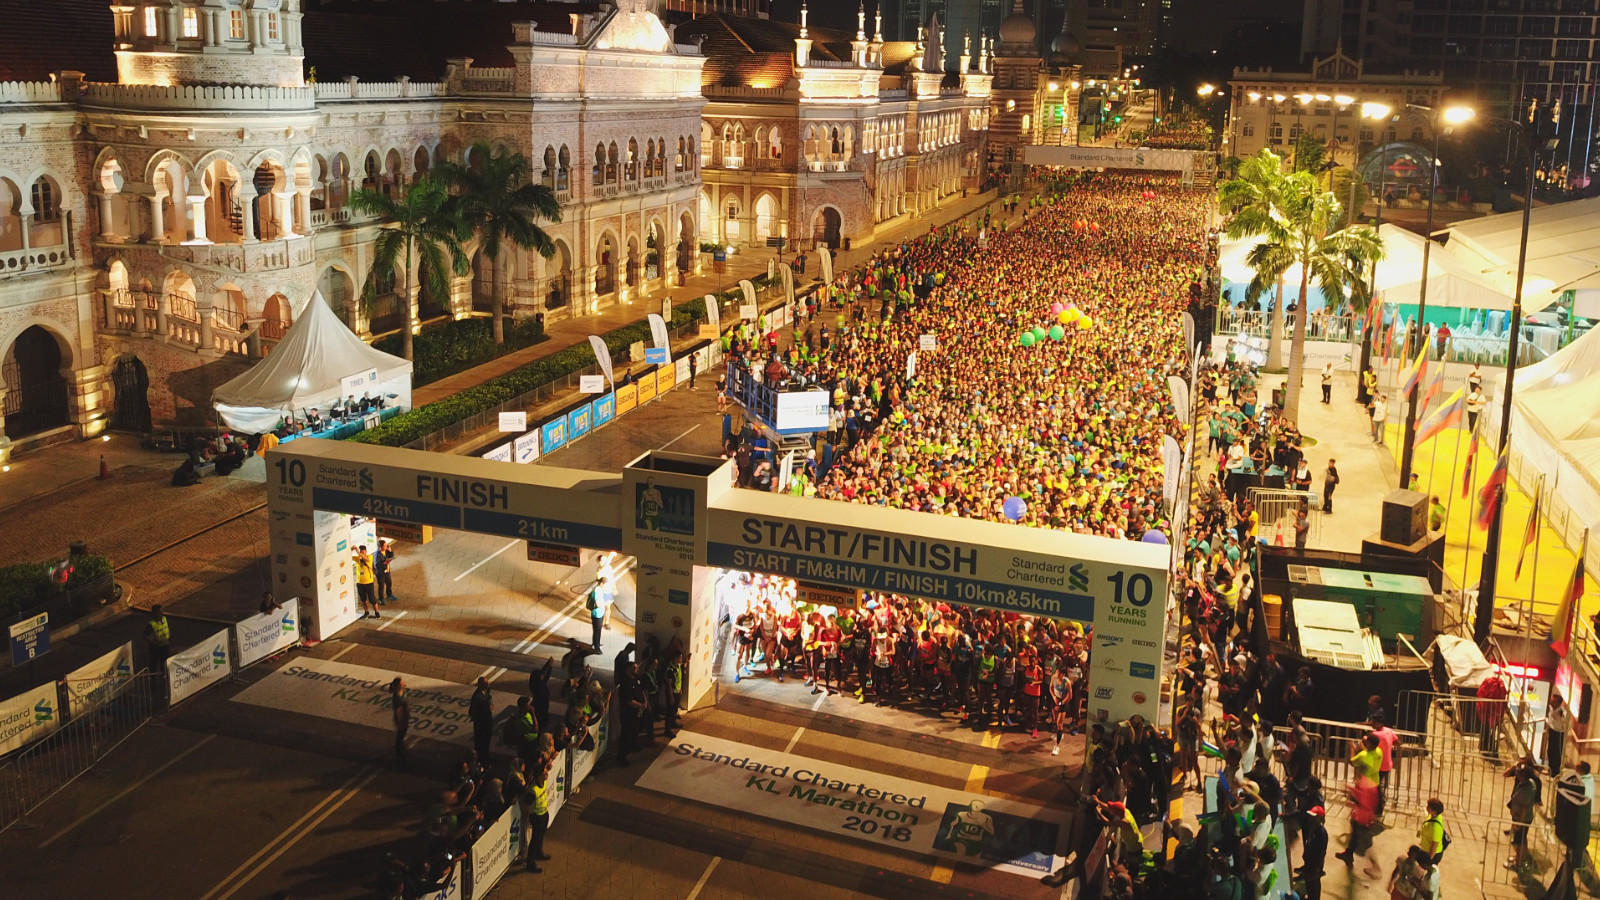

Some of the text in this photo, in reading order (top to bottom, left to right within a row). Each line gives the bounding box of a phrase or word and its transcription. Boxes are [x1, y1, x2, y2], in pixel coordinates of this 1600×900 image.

[1070, 153, 1099, 161] Standard
[349, 377, 364, 387] TIMER
[659, 371, 674, 385] SEIKO
[640, 381, 654, 395] SEIKO
[618, 391, 635, 405] SEIKO
[275, 457, 307, 487] 10
[319, 464, 357, 477] Standard
[316, 474, 357, 488] Chartered
[279, 486, 304, 497] YEARS
[417, 475, 509, 510] FINISH
[363, 497, 409, 517] 42km
[384, 528, 413, 539] SEIKO
[518, 519, 568, 540] 21km
[636, 532, 662, 543] Standard
[742, 518, 977, 575] START/FINISH
[537, 551, 570, 563] SEIKO
[1012, 557, 1065, 574] Standard
[733, 550, 791, 573] START
[796, 560, 866, 584] FM&HM
[884, 572, 949, 596] FINISH
[954, 582, 1062, 613] 10km&5km
[1007, 569, 1064, 587] Chartered
[808, 591, 844, 605] SEIKO
[1107, 571, 1153, 607] 10
[1109, 605, 1147, 618] YEARS
[244, 619, 280, 641] Standard
[1108, 615, 1147, 627] RUNNING
[242, 629, 280, 653] Chartered
[1096, 633, 1124, 643] BROOKS
[28, 647, 36, 658] B
[175, 653, 210, 678] Standard
[76, 667, 115, 693] Standard
[173, 663, 211, 690] Chartered
[282, 666, 381, 690] Standard
[74, 678, 115, 706] Chartered
[331, 688, 360, 702] KL
[674, 743, 927, 810] Standard Chartered
[745, 775, 919, 826] KL Marathon
[841, 816, 912, 843] 2018
[965, 824, 978, 834] 10
[478, 832, 508, 869] Standard
[475, 845, 507, 884] Chartered
